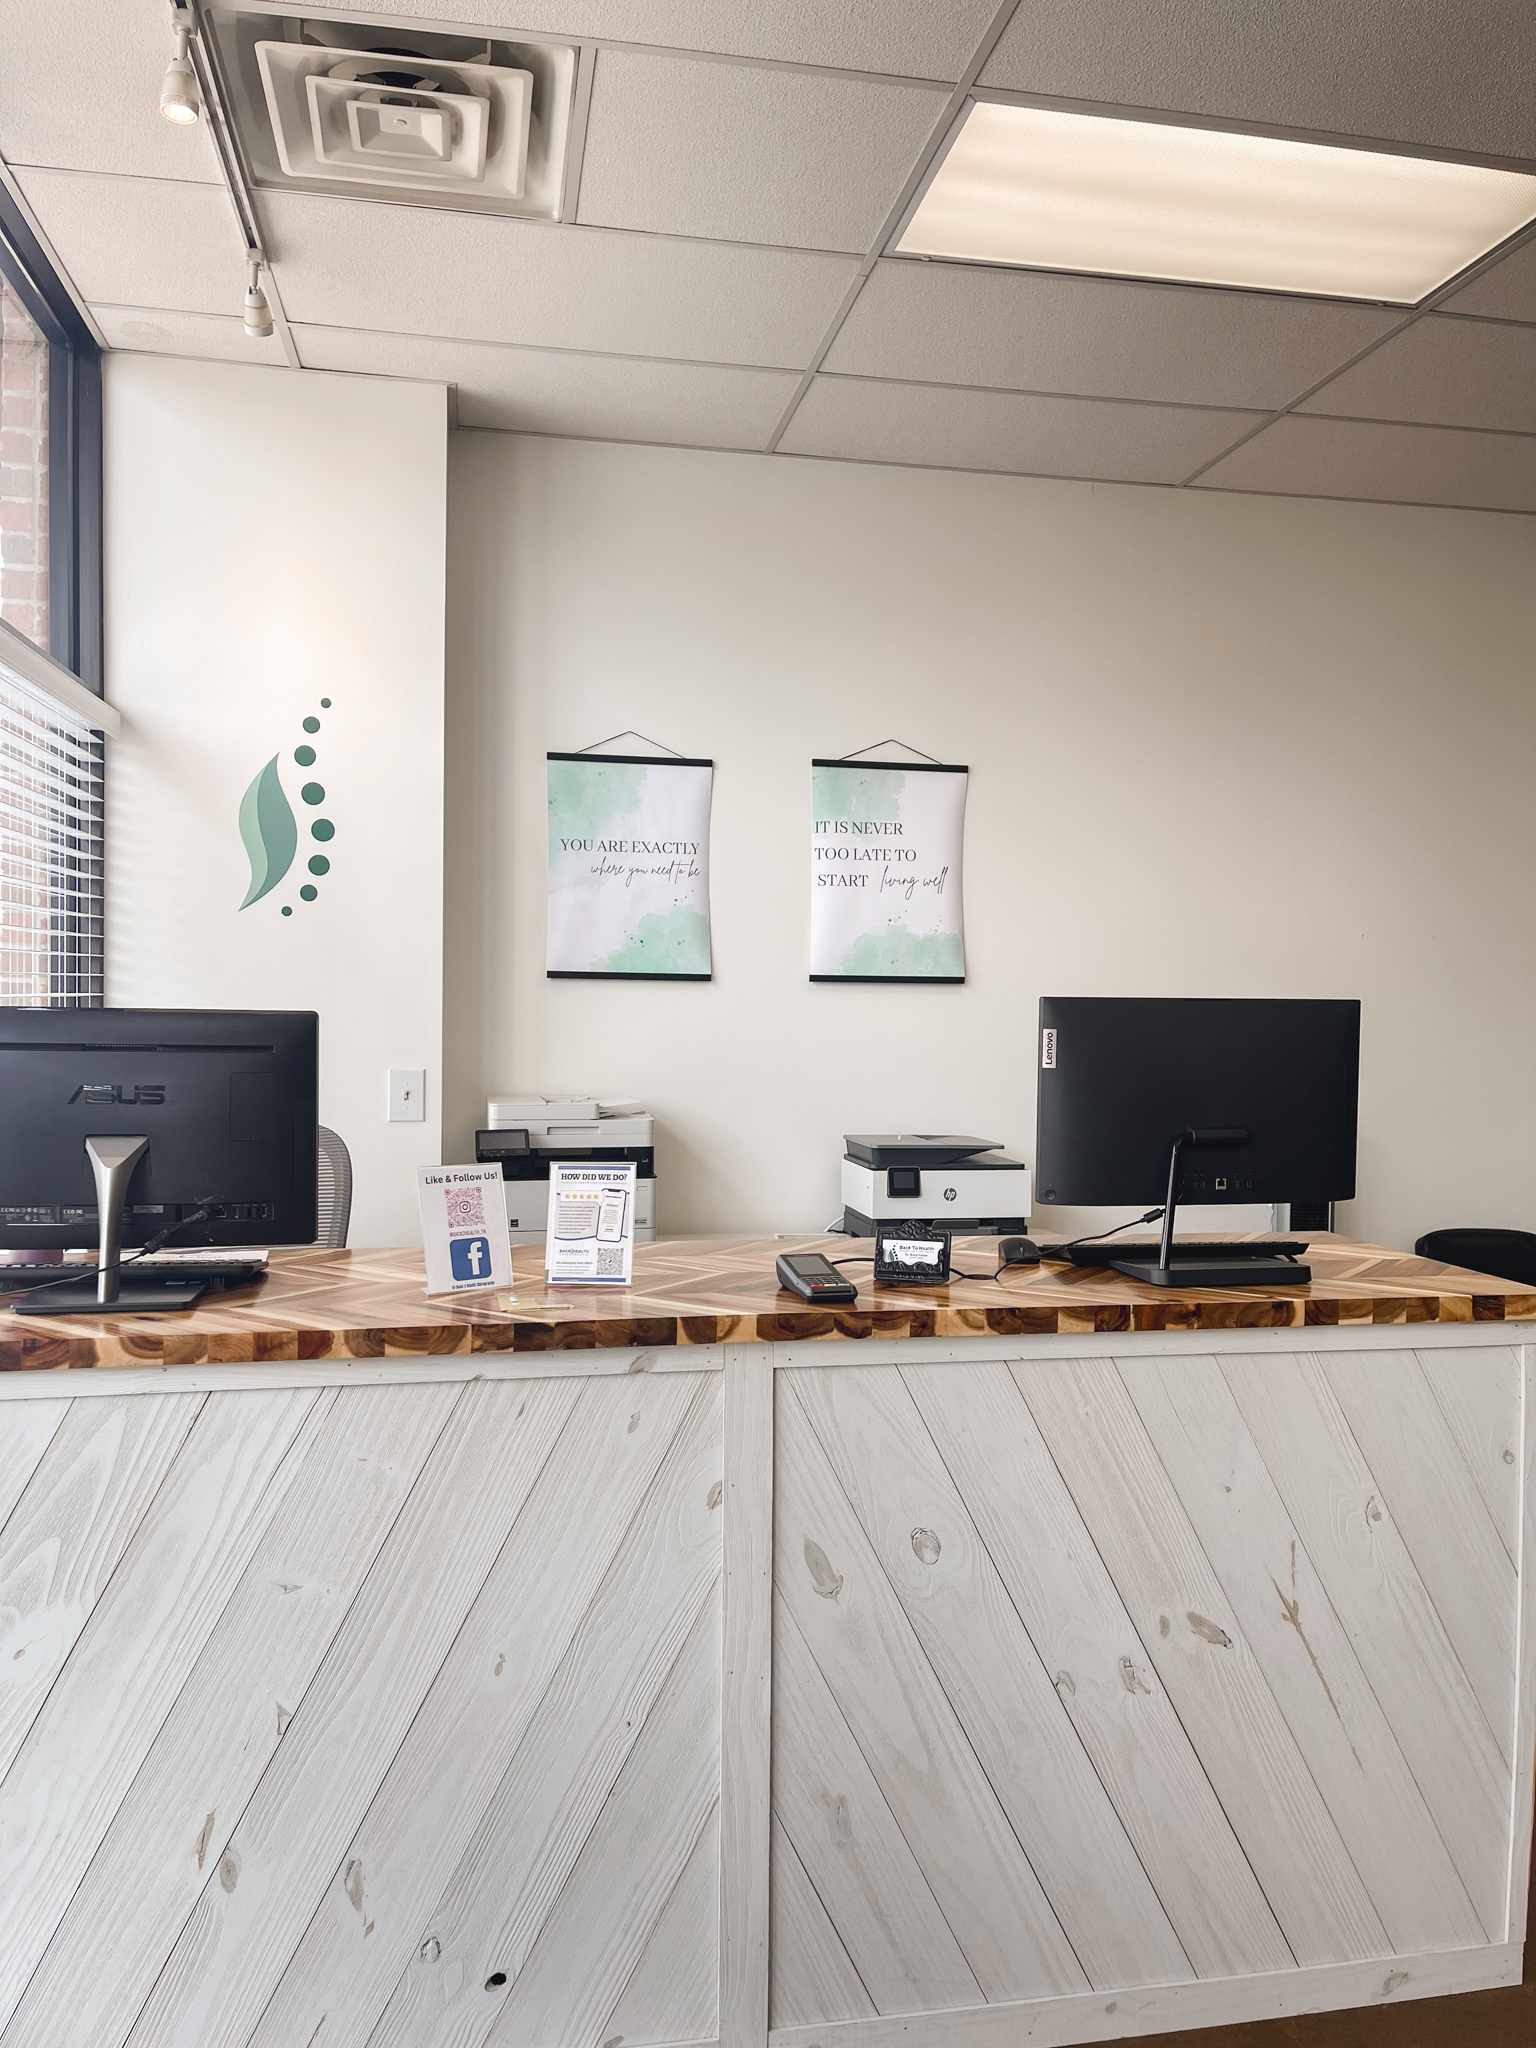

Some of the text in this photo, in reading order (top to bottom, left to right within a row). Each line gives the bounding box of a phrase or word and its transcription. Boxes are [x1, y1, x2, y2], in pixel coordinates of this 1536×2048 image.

[815, 821, 903, 835] IT IS NEVER
[560, 839, 700, 854] YOU ARE EXACTLY
[815, 847, 917, 861] TOO LATE TO
[591, 856, 700, 887] where you need to be
[818, 865, 949, 900] START living well
[1045, 1032, 1053, 1065] Lenovo
[67, 1084, 166, 1105] ASUS
[425, 1172, 498, 1184] Like & Follow Us!
[945, 1188, 956, 1201] hp
